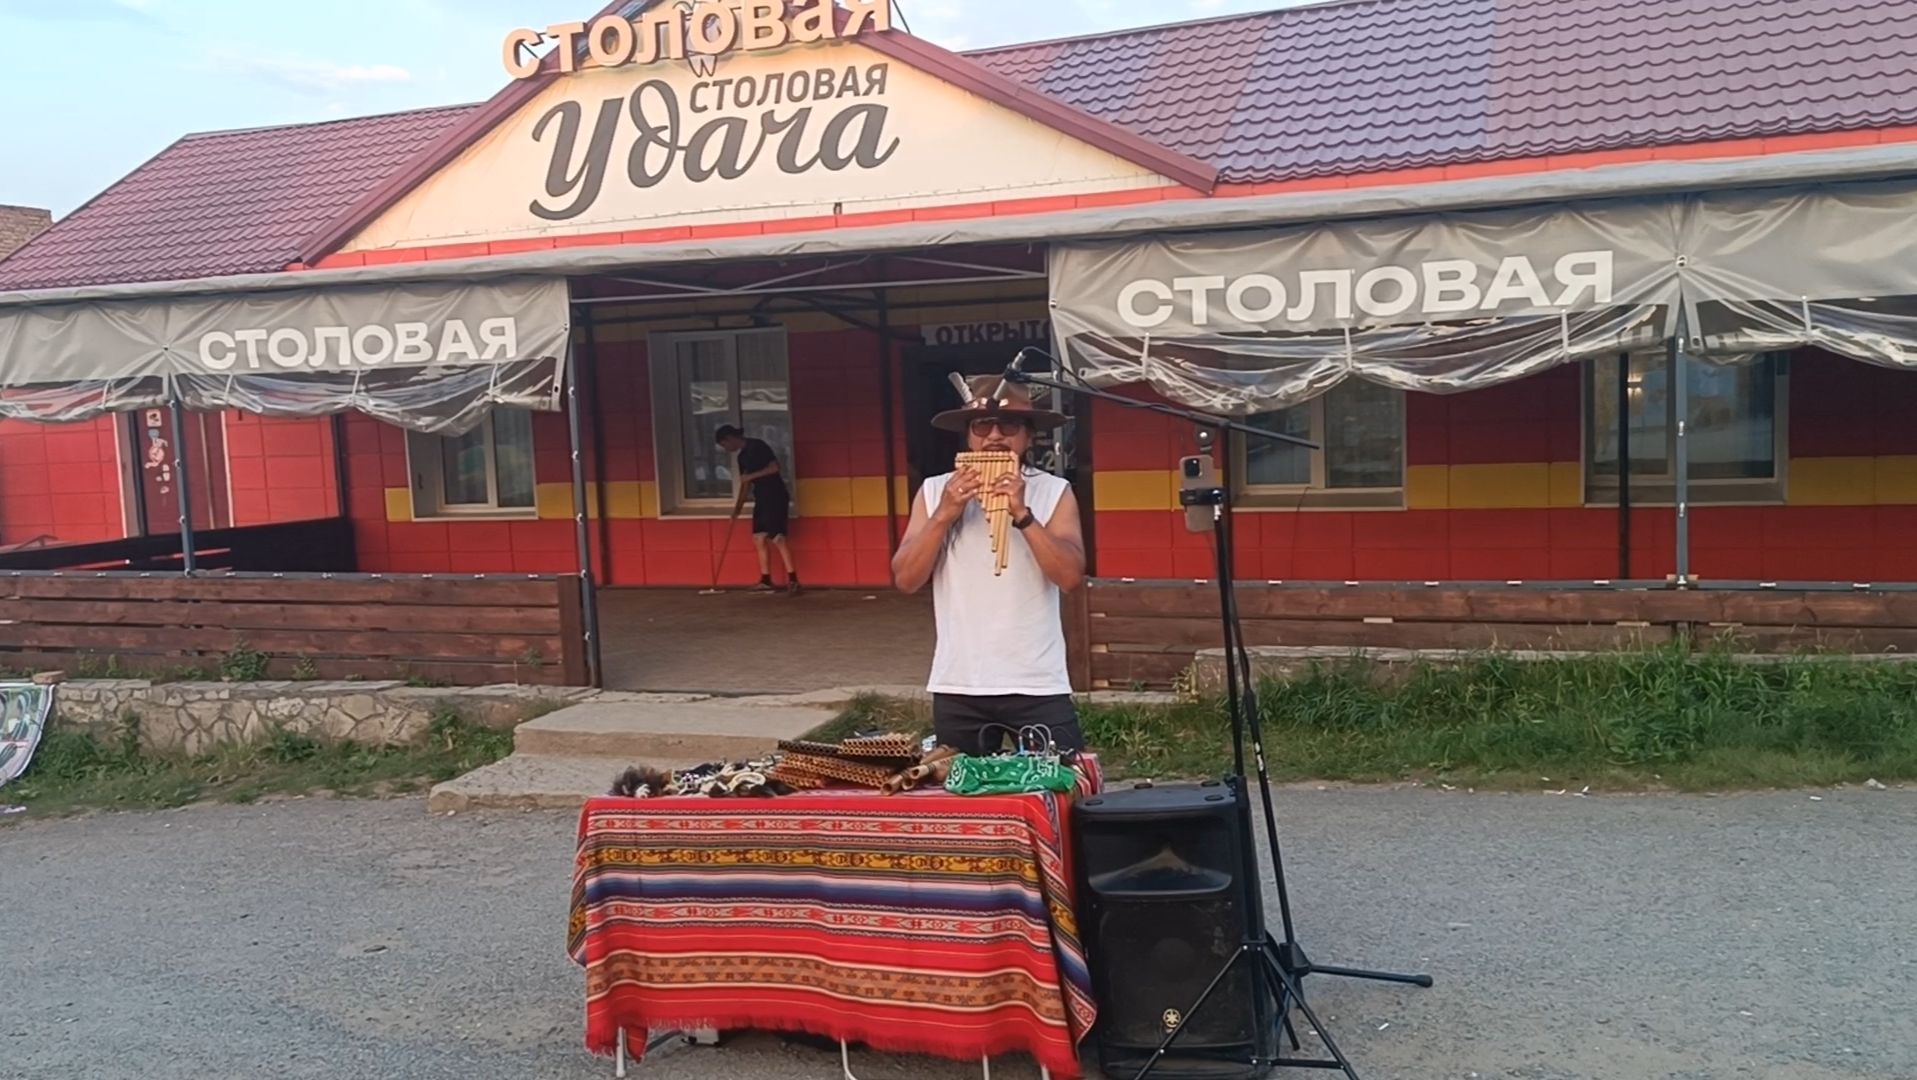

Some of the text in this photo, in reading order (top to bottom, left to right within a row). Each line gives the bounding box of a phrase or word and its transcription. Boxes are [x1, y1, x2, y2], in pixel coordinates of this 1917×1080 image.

[689, 63, 889, 113] СТОЛОВАЯ
[529, 79, 900, 221] Удача
[1116, 250, 1614, 328] СТОЛОВАЯ
[199, 317, 517, 370] СТОЛОВАЯ
